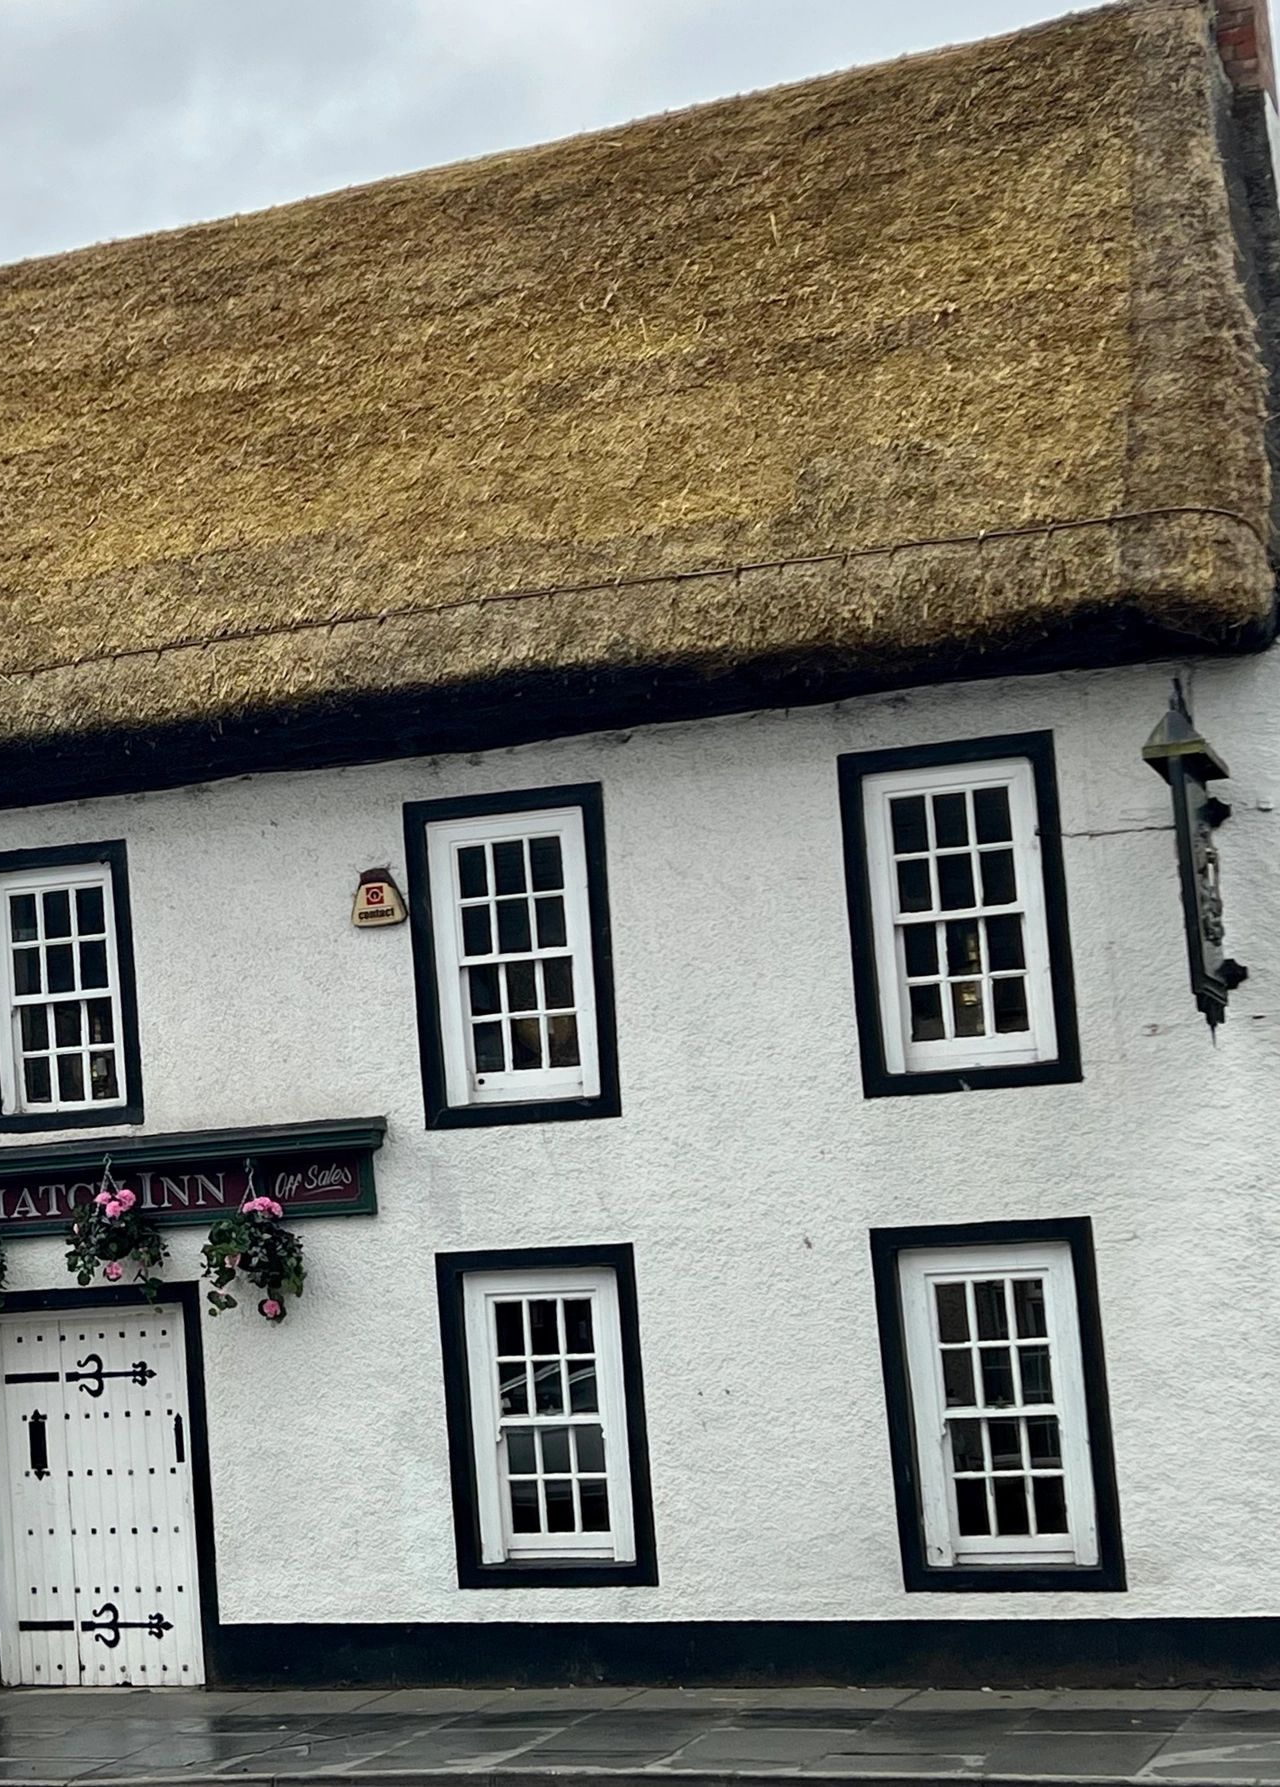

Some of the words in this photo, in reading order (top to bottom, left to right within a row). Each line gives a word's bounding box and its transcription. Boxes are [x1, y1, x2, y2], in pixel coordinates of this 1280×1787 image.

[136, 1172, 225, 1209] INN
[275, 1172, 302, 1200] Off
[304, 1163, 352, 1189] Sales
